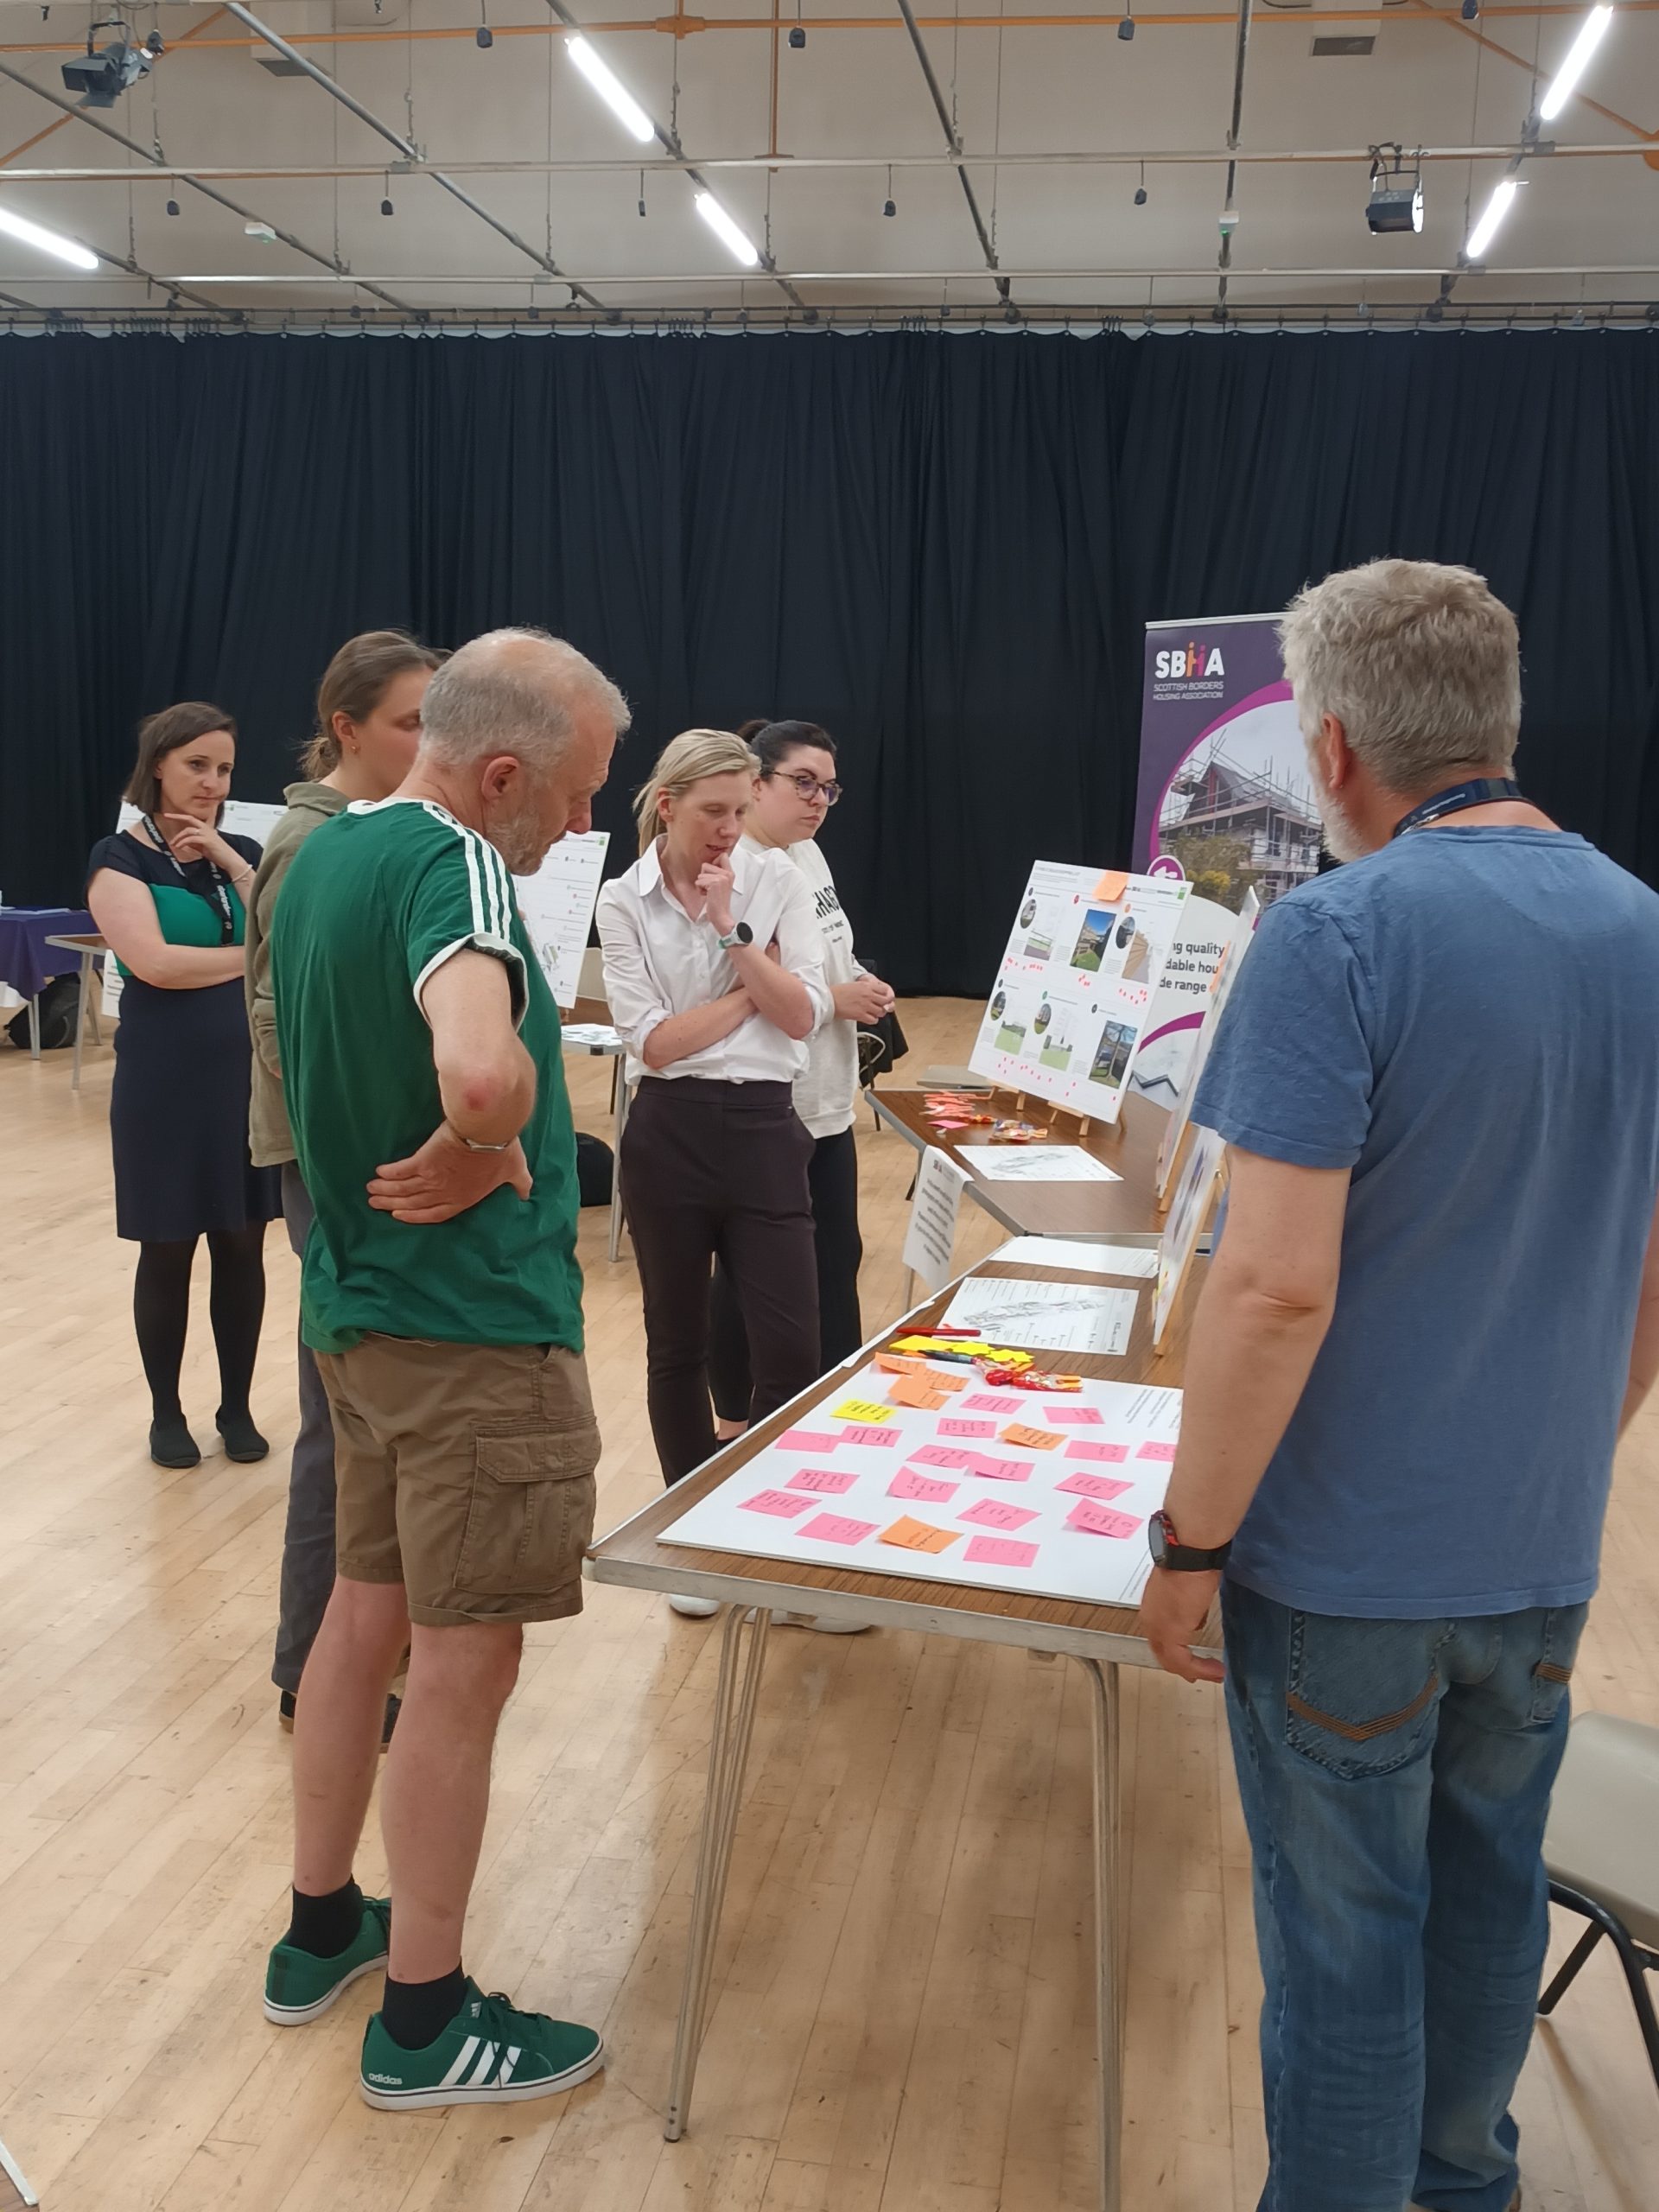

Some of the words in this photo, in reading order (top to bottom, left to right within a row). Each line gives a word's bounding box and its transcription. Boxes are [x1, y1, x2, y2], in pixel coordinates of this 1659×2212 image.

[1154, 641, 1224, 678] SBHA
[1185, 942, 1225, 958] quality
[1174, 981, 1207, 995] range
[368, 2072, 403, 2085] adidas
